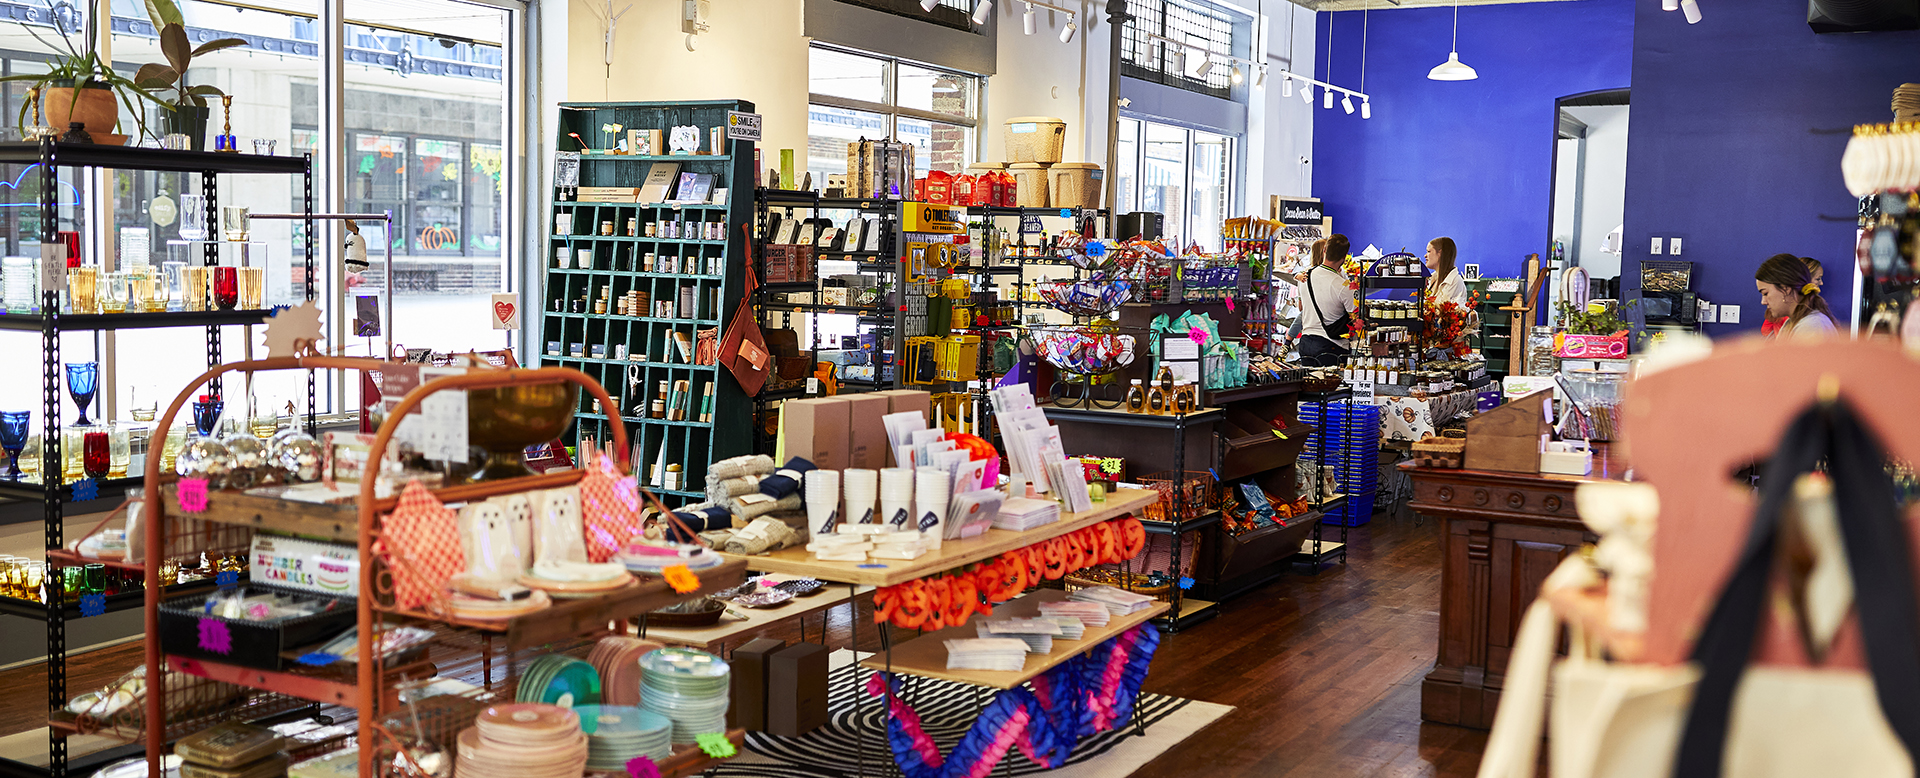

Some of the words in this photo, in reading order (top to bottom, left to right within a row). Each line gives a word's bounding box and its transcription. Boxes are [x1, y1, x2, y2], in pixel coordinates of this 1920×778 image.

[738, 117, 752, 126] SMILE
[767, 249, 786, 257] URGER
[905, 296, 926, 315] THEIR
[905, 316, 928, 336] GROO
[1107, 460, 1116, 470] $1
[78, 481, 91, 490] $10
[258, 554, 302, 570] NUMBER
[266, 568, 313, 585] CANDLES
